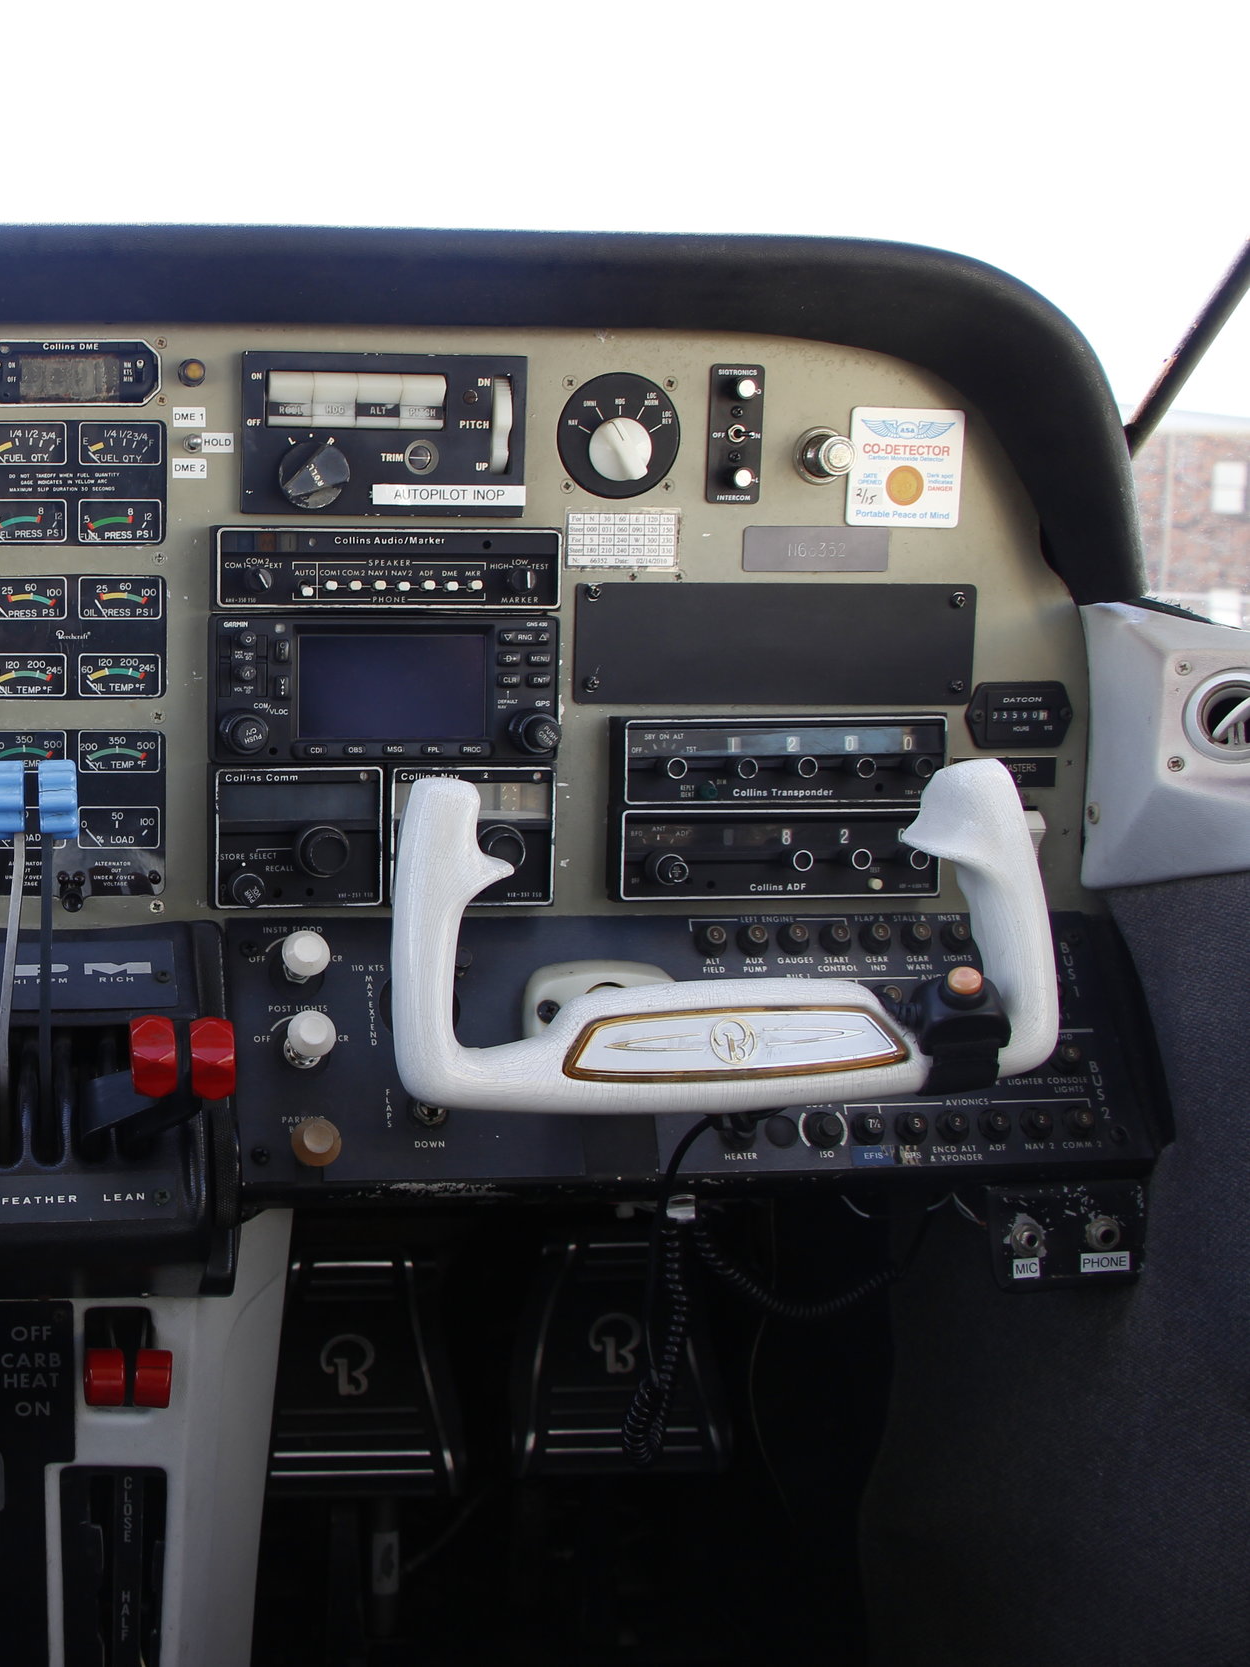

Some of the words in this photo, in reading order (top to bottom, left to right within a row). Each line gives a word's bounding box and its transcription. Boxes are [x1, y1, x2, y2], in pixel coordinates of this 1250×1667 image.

[251, 372, 262, 380] ON
[370, 406, 386, 415] ALT
[459, 420, 489, 428] PITCH
[204, 438, 231, 446] HOLD
[863, 443, 950, 456] CO-DETECTOR
[4, 454, 26, 462] FUEL
[381, 453, 403, 462] TRIM
[175, 464, 196, 472] DME
[200, 464, 205, 472] 2
[394, 489, 468, 500] AUTOPILOT
[473, 489, 505, 500] INOP
[856, 510, 890, 518] Portable
[930, 511, 949, 519] Mind
[334, 536, 371, 545] Collins
[373, 537, 445, 545] Audio/Marker
[266, 774, 298, 782] Comm
[732, 788, 768, 797] Collins
[771, 788, 833, 798] Transponder
[110, 836, 134, 844] LOAD
[750, 883, 784, 891] Collins
[787, 883, 806, 891] ADF
[946, 1098, 989, 1106] AVIONICS
[385, 1089, 393, 1128] FLAPS
[414, 1140, 445, 1148] DOWN
[1, 1194, 78, 1205] FEATHER
[103, 1192, 146, 1202] LEAN
[1082, 1256, 1127, 1269] PHONE
[1015, 1262, 1038, 1275] MIC
[10, 1325, 52, 1341] OFF
[1, 1352, 62, 1368] CARB
[3, 1373, 60, 1389] HEAT
[15, 1401, 51, 1417] ON
[122, 1476, 133, 1544] CLOSE
